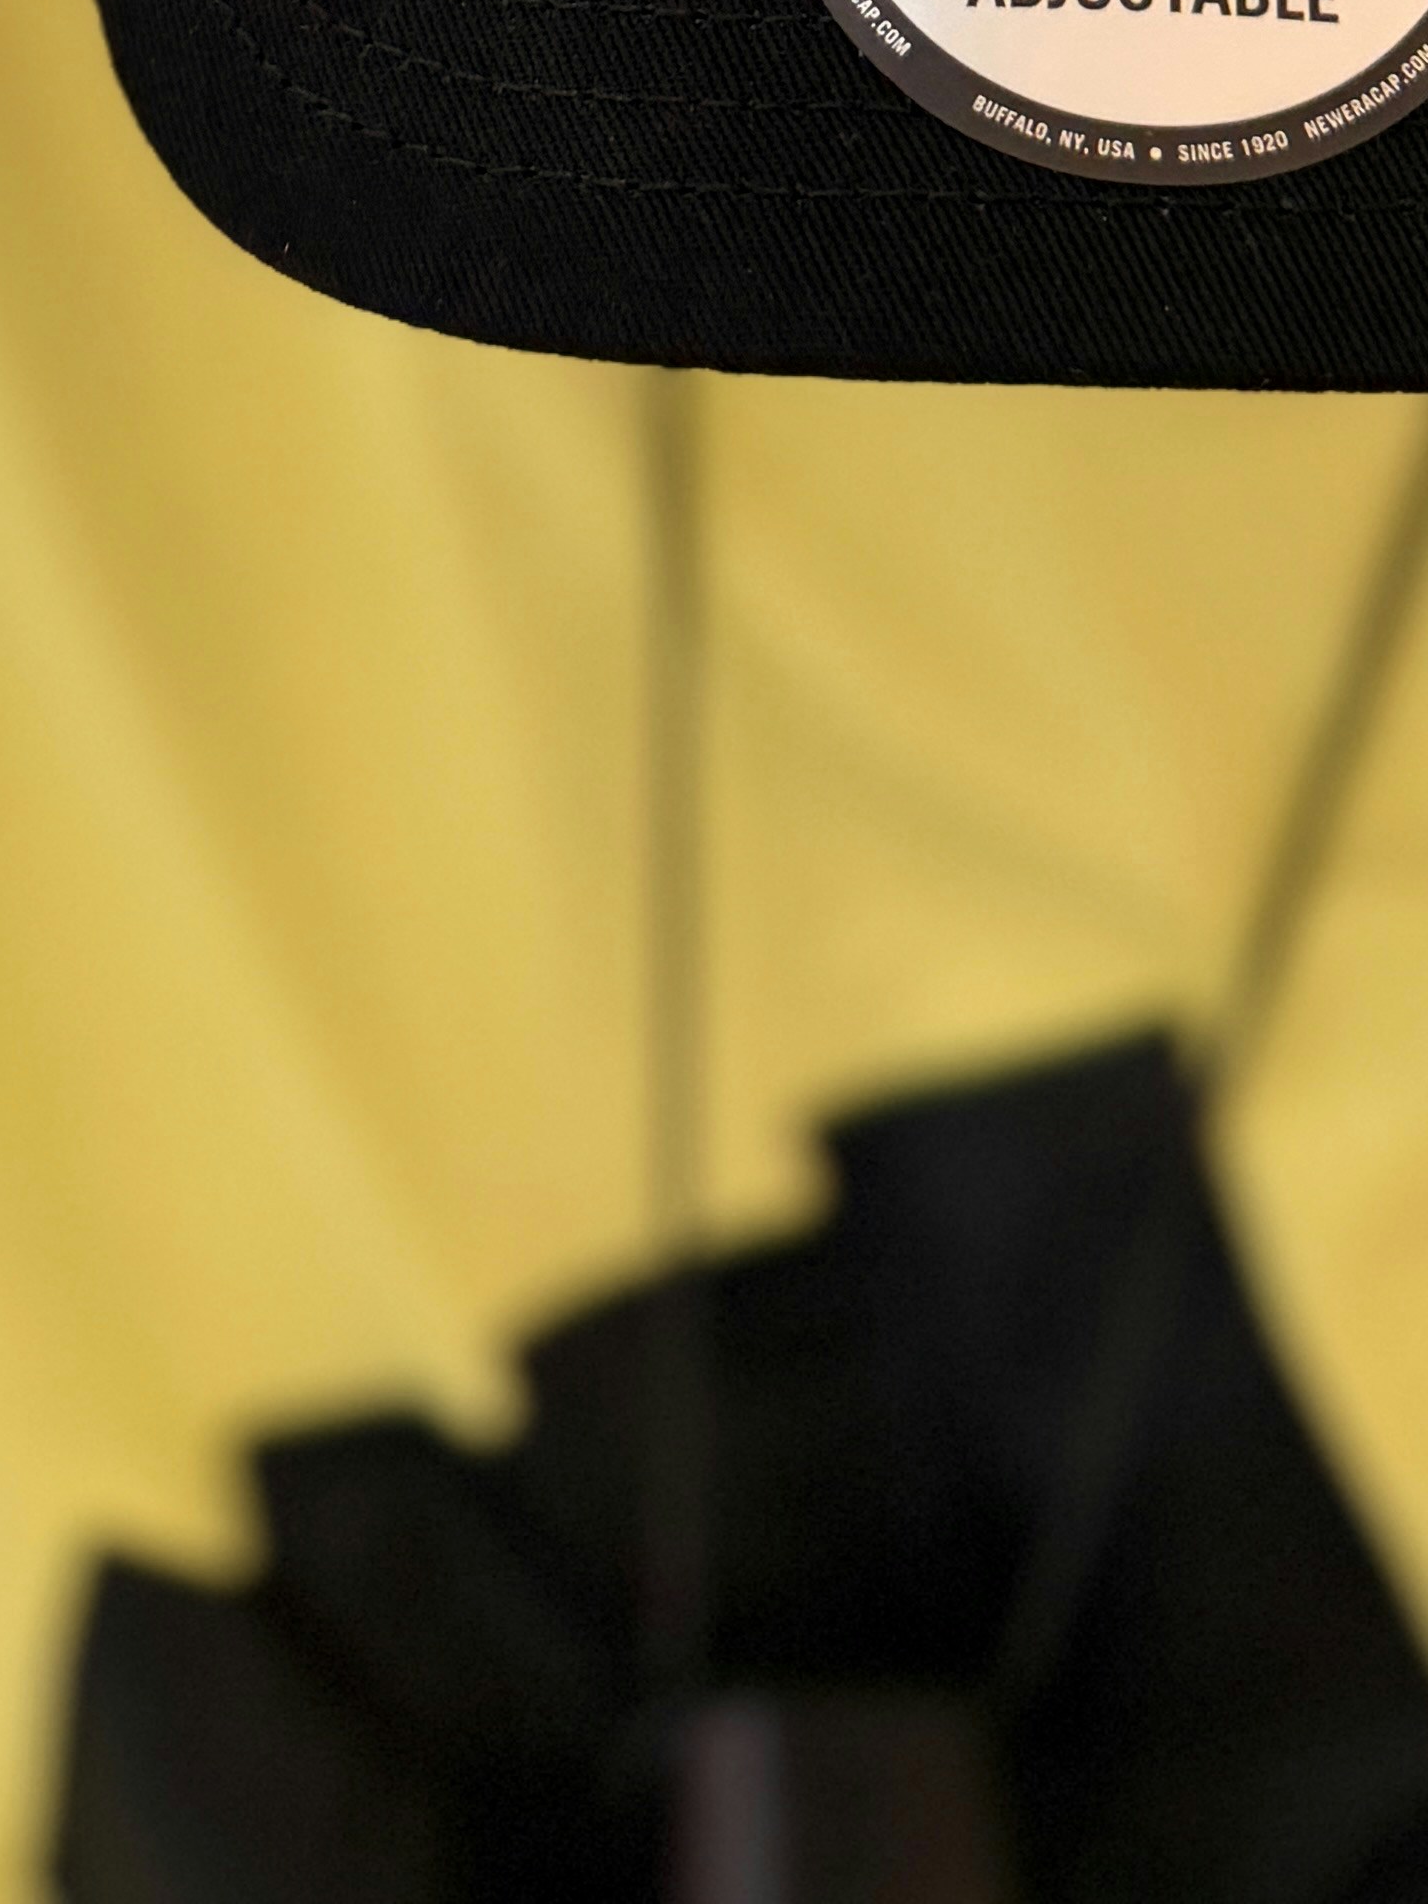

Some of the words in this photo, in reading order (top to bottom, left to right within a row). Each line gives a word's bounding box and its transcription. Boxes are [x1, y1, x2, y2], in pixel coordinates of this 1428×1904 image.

[972, 95, 1052, 145] BUFFALO,
[1097, 138, 1135, 161] USA
[1178, 141, 1234, 163] SINCE
[1241, 130, 1289, 157] 1920
